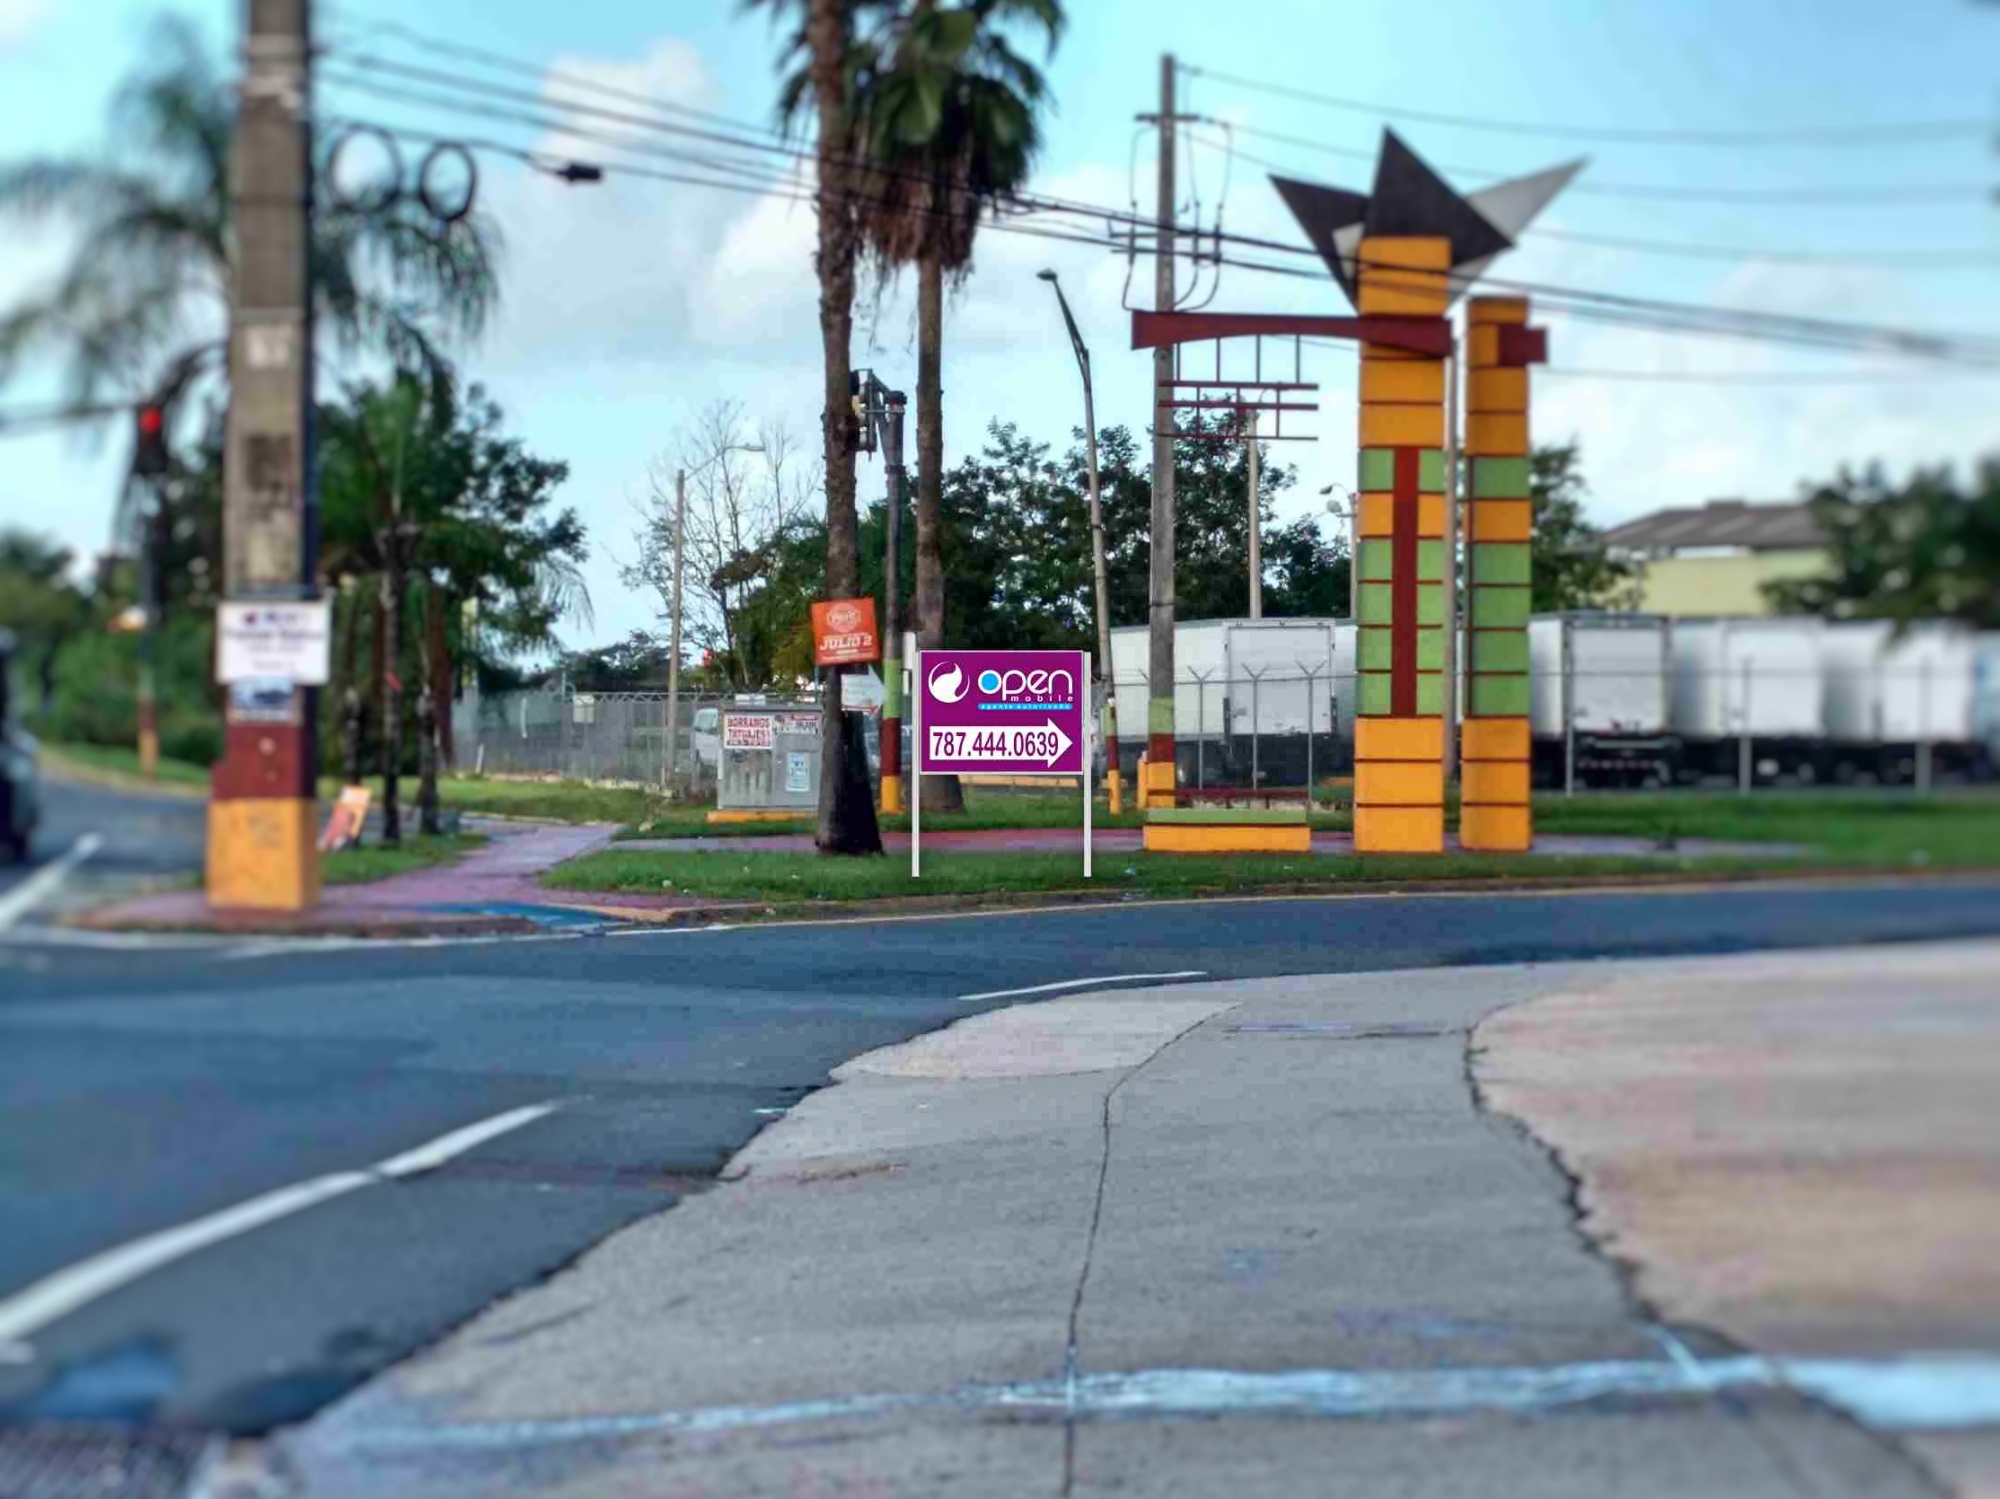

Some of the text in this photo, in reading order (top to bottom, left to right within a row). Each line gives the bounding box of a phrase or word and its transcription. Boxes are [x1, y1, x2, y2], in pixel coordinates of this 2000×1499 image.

[977, 669, 1073, 701] open
[1010, 694, 1073, 702] mobile
[933, 731, 1059, 757] 787.444.0639
